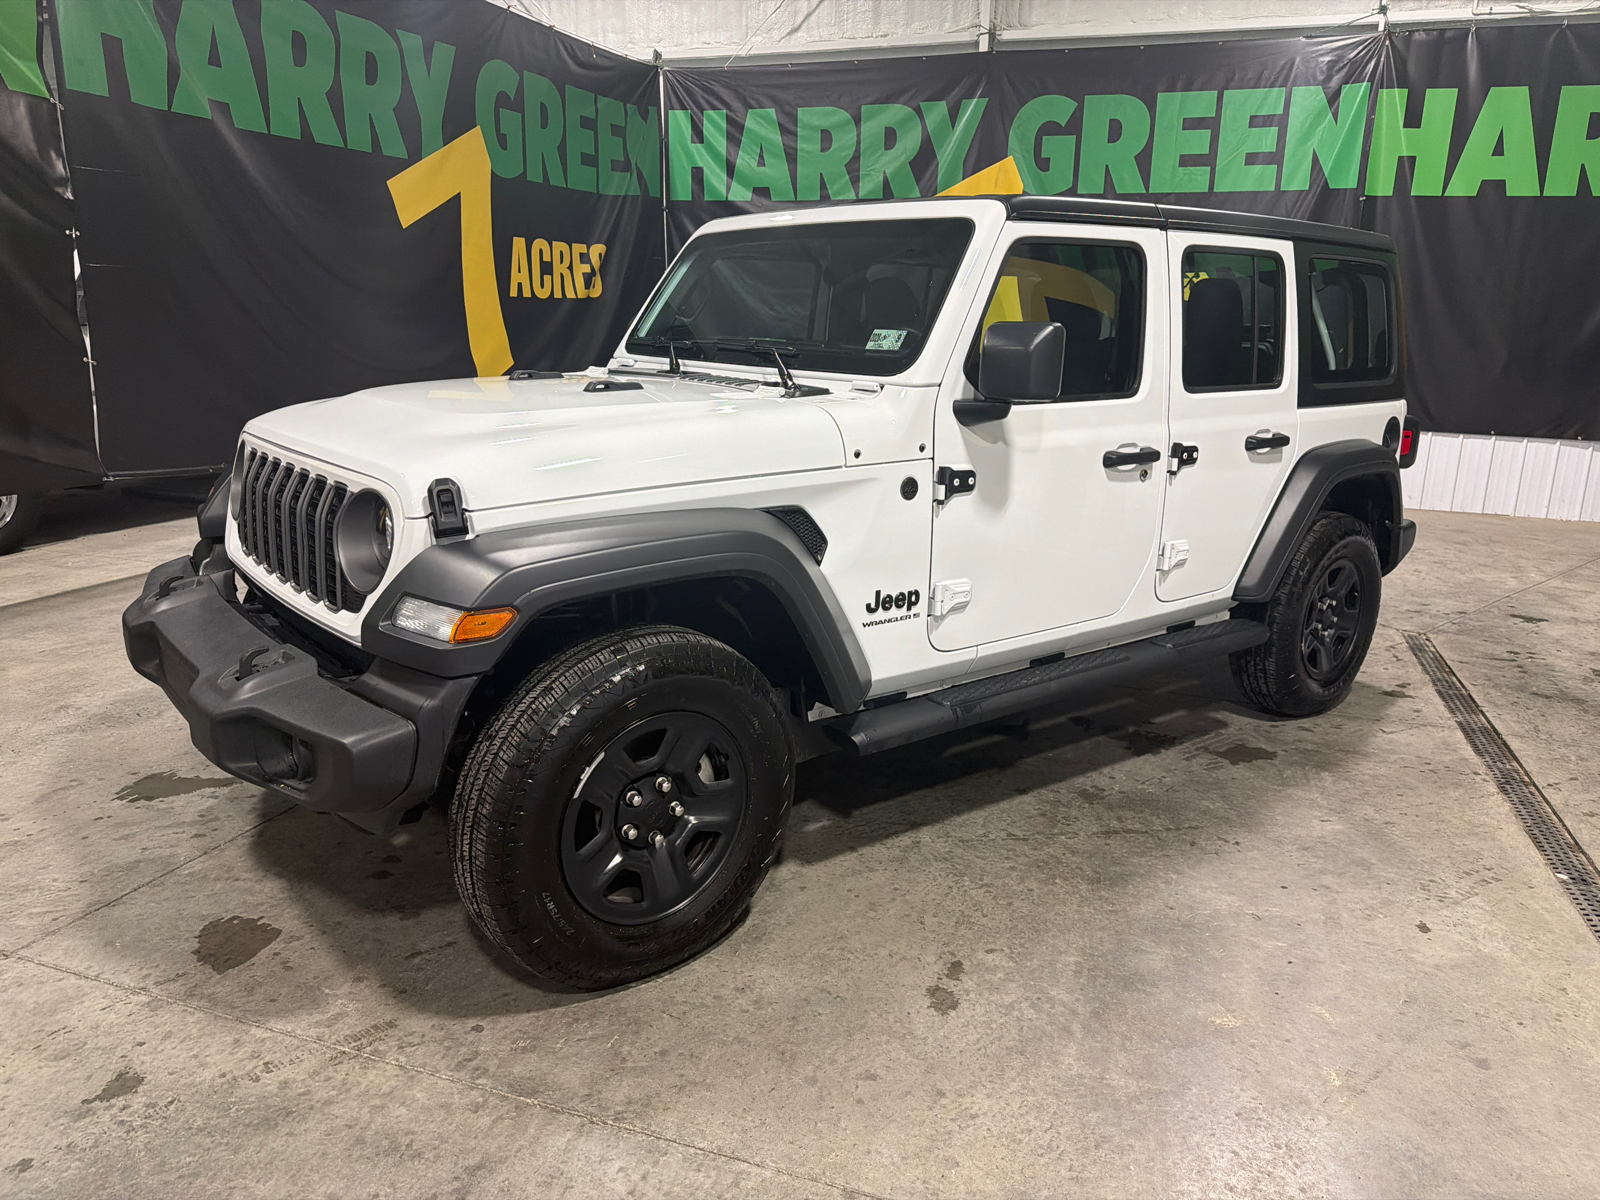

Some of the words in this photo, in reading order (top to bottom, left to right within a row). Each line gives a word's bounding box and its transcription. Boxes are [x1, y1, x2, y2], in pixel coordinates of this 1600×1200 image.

[55, 0, 456, 160] HARRY
[475, 58, 661, 198] GREEN
[668, 97, 988, 201] HARRY
[1008, 82, 1371, 196] GREEN
[509, 236, 607, 299] ACRES
[861, 614, 912, 628] WRANGLER
[865, 588, 921, 614] Jeep
